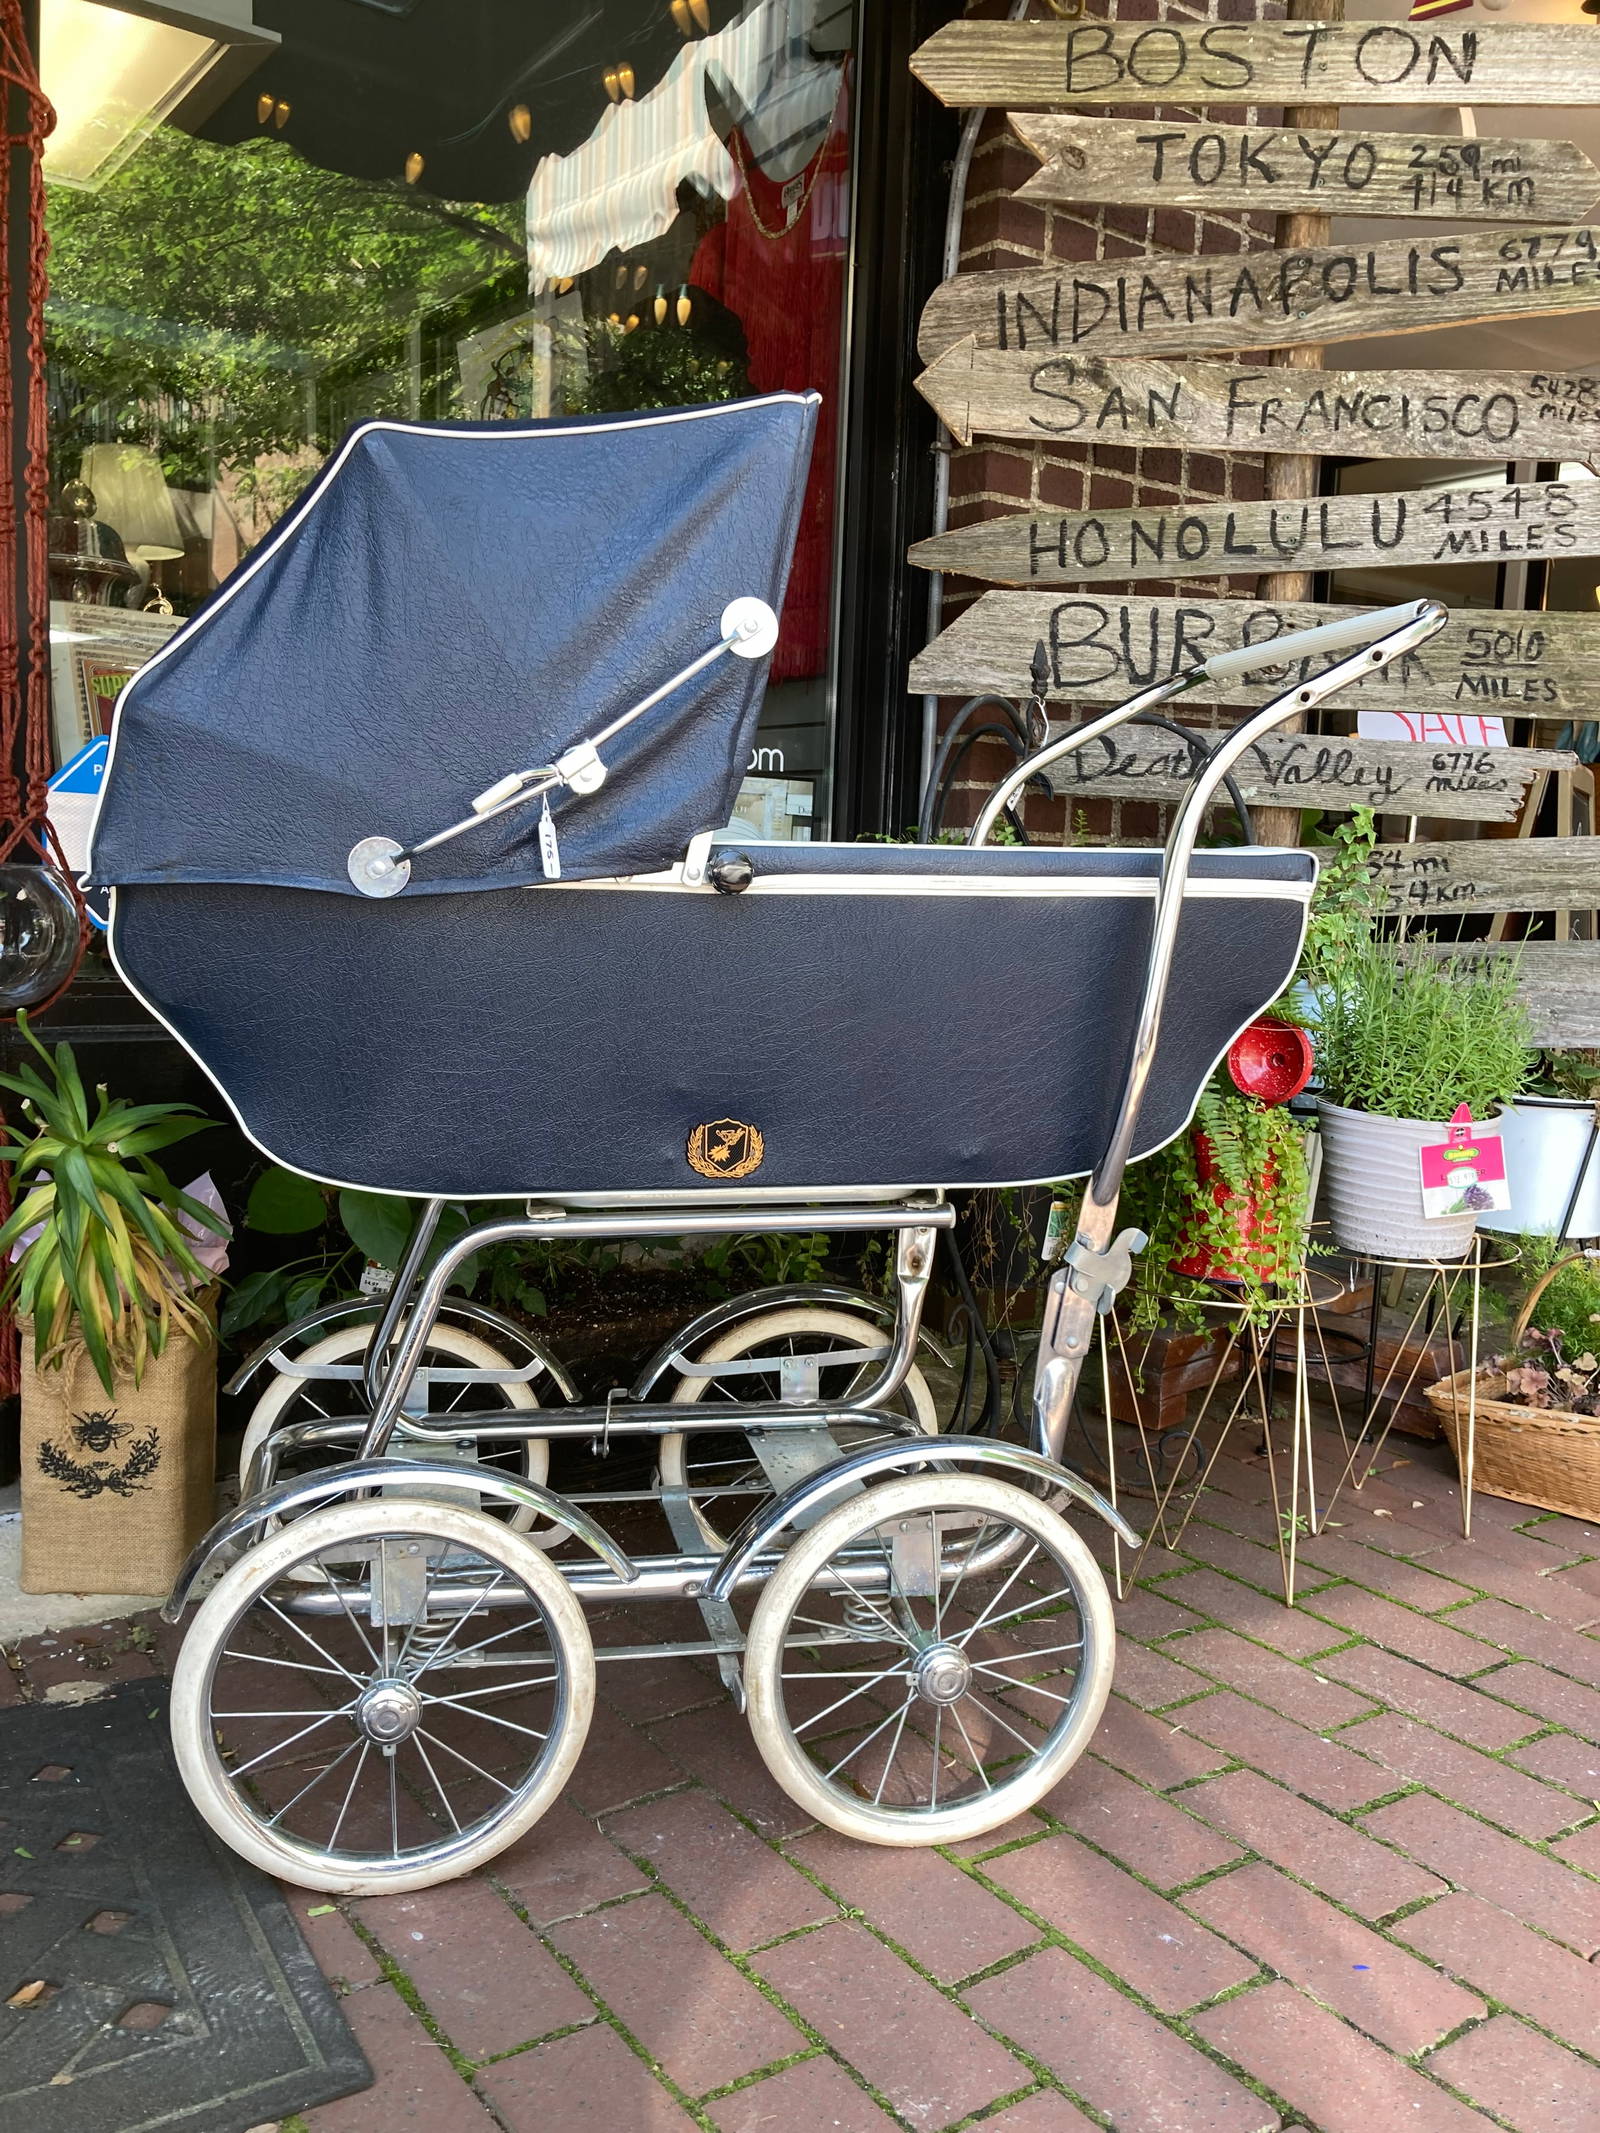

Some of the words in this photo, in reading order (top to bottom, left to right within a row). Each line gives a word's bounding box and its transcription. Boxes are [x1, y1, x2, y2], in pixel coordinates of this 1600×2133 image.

[1065, 25, 1477, 93] BOSTON
[1136, 132, 1377, 190] TOKYO
[1408, 143, 1481, 181] 259
[1491, 147, 1521, 173] mi
[1498, 230, 1598, 260] 6779
[997, 245, 1465, 350] INDIANAPOLIS
[1029, 498, 1406, 575] HONOLULU
[1433, 524, 1577, 560] MILES
[1464, 626, 1545, 661] 5010
[1455, 673, 1558, 701] MILES
[1250, 742, 1412, 806] Valley
[1432, 752, 1496, 774] 6776
[1425, 774, 1508, 792] miles
